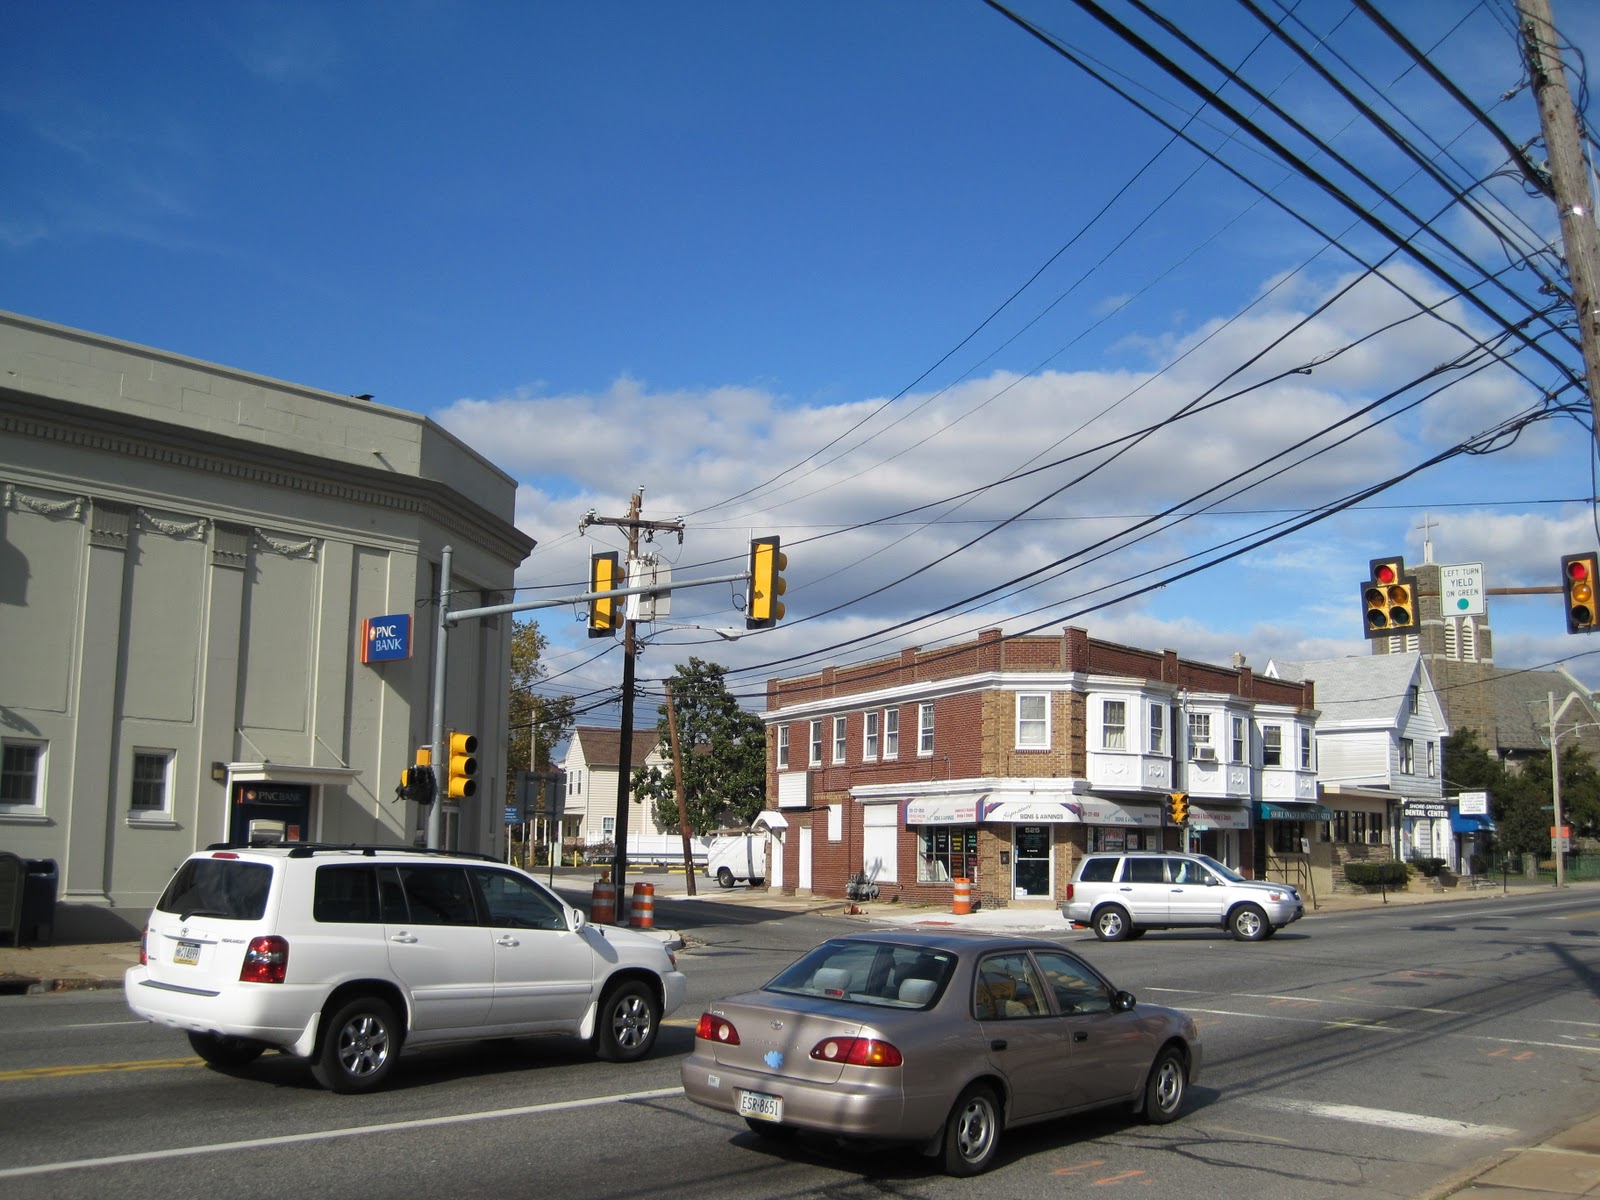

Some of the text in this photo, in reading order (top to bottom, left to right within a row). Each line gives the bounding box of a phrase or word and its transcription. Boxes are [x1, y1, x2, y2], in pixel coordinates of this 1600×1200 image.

[1451, 578, 1473, 587] YIELD
[376, 625, 397, 638] PNC
[375, 638, 402, 652] BANK
[258, 791, 278, 800] PNC
[1427, 810, 1448, 818] CENTER
